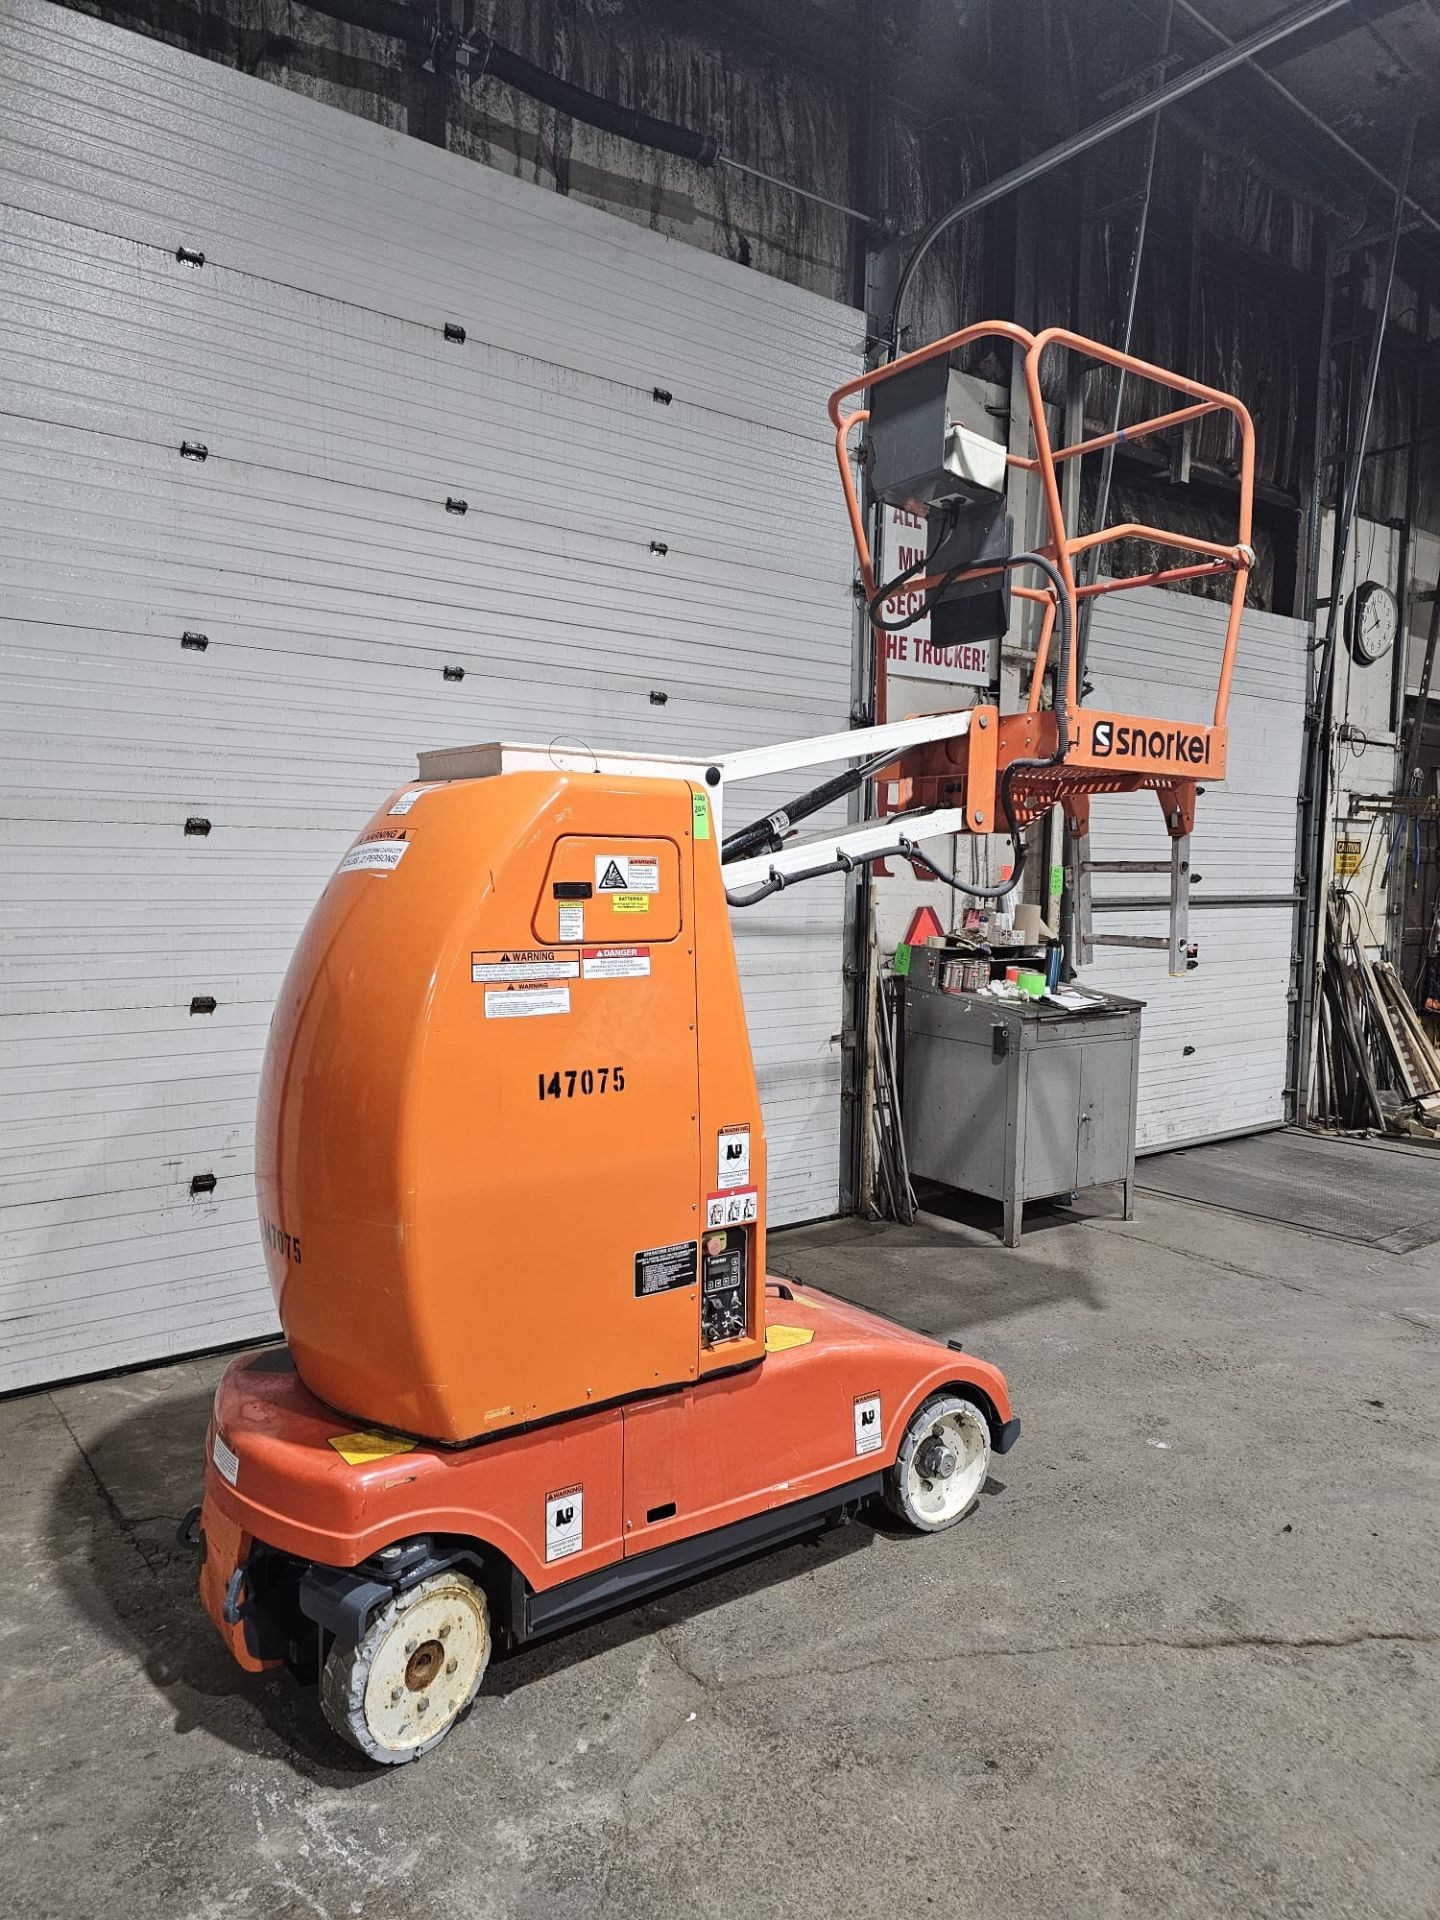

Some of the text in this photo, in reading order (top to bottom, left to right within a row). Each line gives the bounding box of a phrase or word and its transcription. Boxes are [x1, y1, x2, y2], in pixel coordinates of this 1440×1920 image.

[898, 545, 925, 574] MU
[886, 591, 929, 620] SECU
[886, 634, 985, 672] HE TRUCKER!
[1115, 726, 1211, 764] snorkel
[1337, 843, 1360, 853] CAUTION
[512, 952, 555, 961] WARNING
[518, 982, 548, 990] WARNING
[538, 1066, 625, 1101] 147075
[725, 1126, 749, 1134] WARNING
[553, 1485, 582, 1499] WARNING
